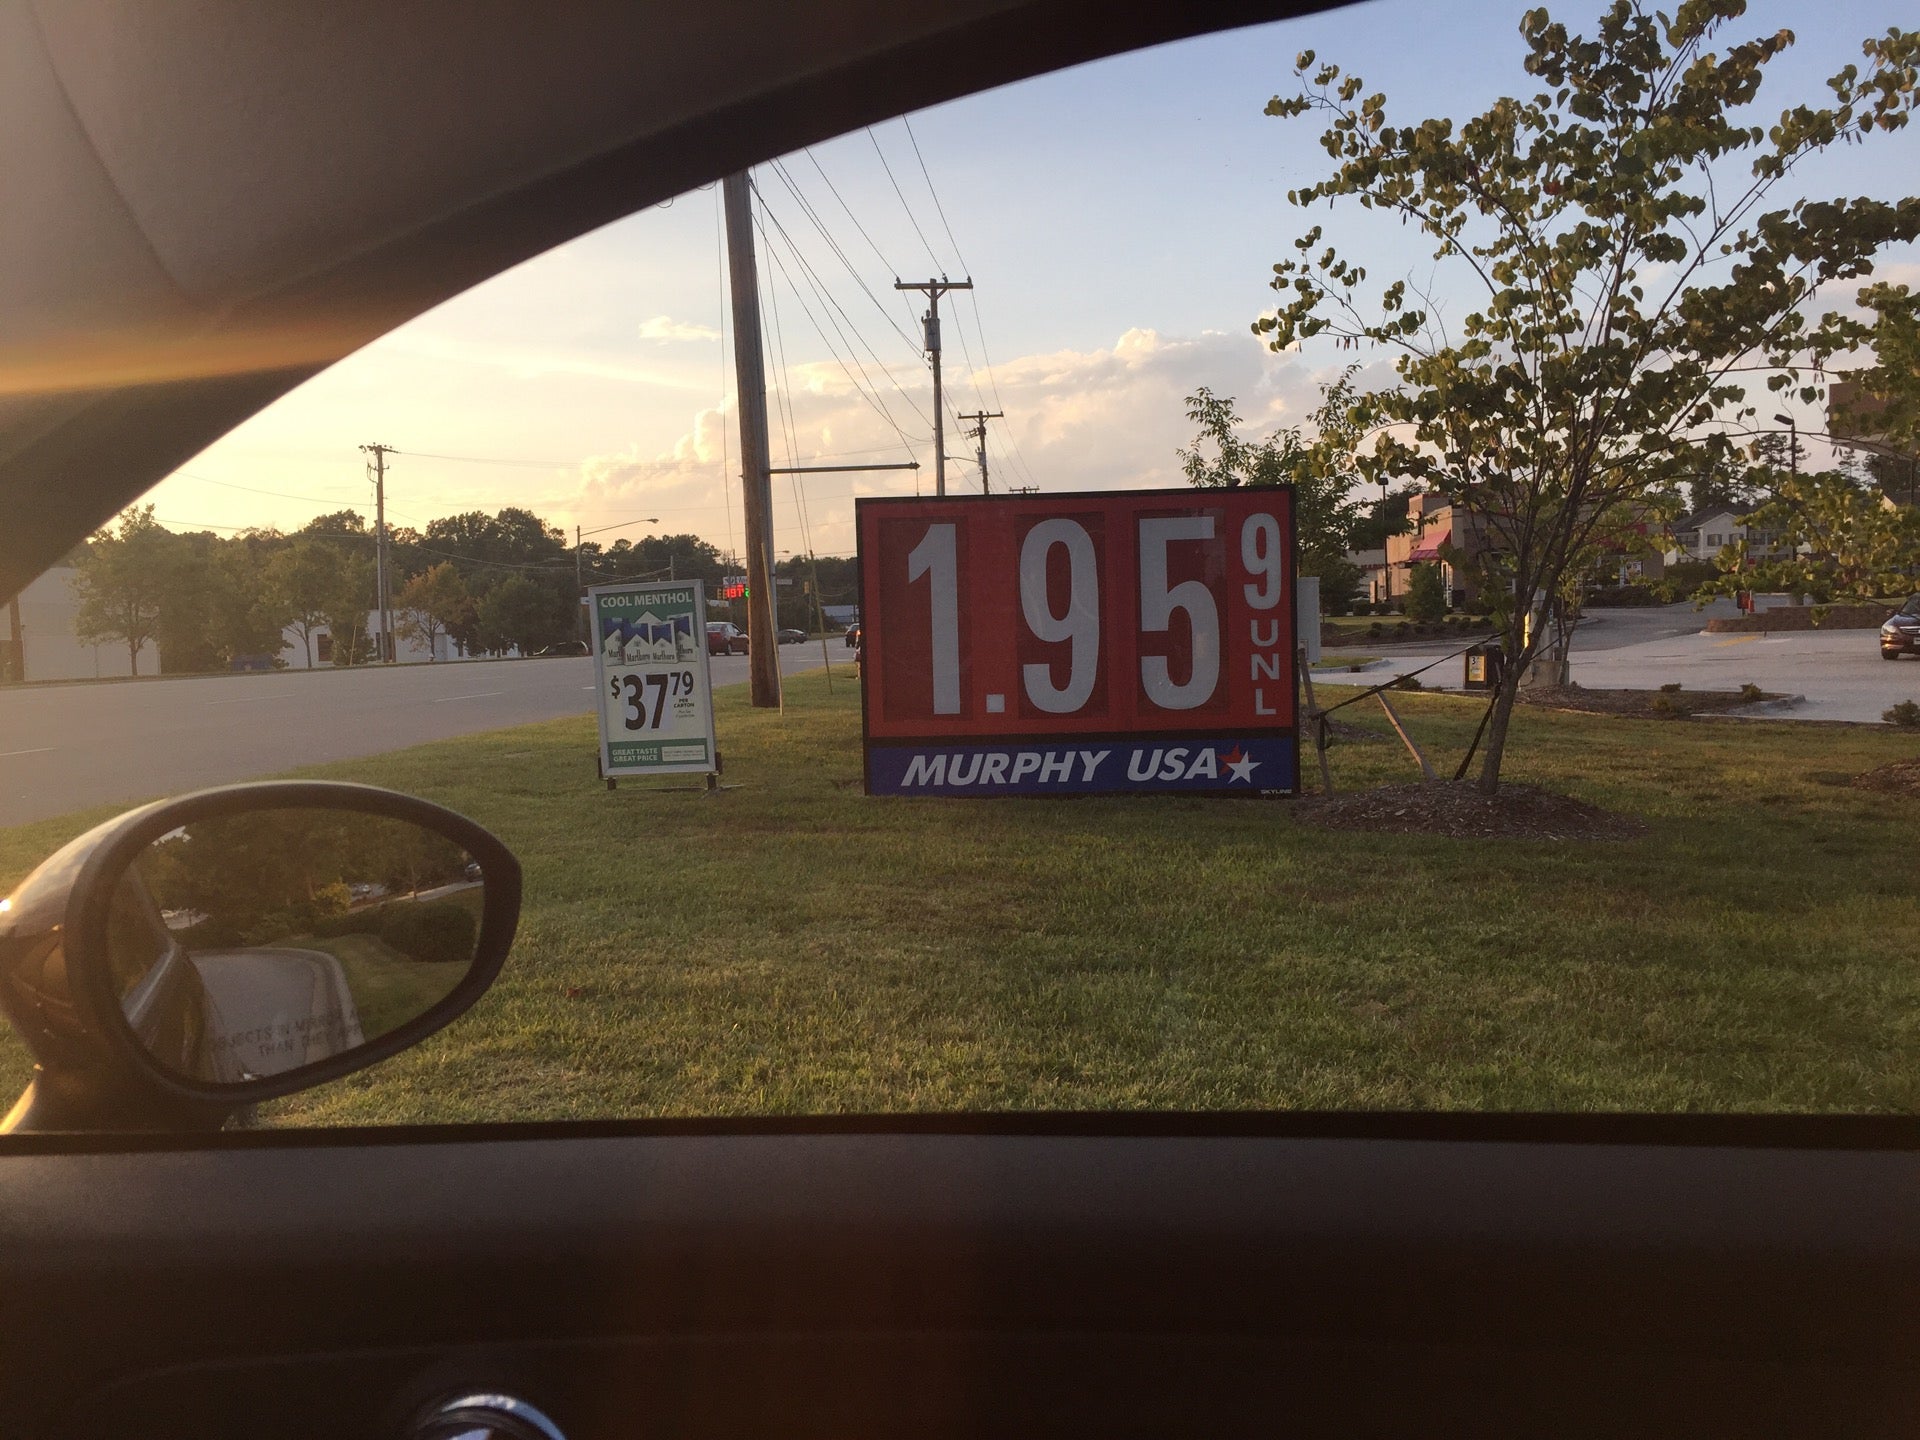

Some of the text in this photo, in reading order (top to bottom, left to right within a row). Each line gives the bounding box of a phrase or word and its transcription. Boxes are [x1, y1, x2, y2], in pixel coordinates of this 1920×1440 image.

[1241, 512, 1282, 610] 9
[601, 592, 693, 608] COOL MENTHOL
[1250, 619, 1280, 716] UNL
[612, 748, 635, 756] GREAT
[635, 747, 658, 755] TASTE
[901, 747, 1219, 787] MURPHY USA
